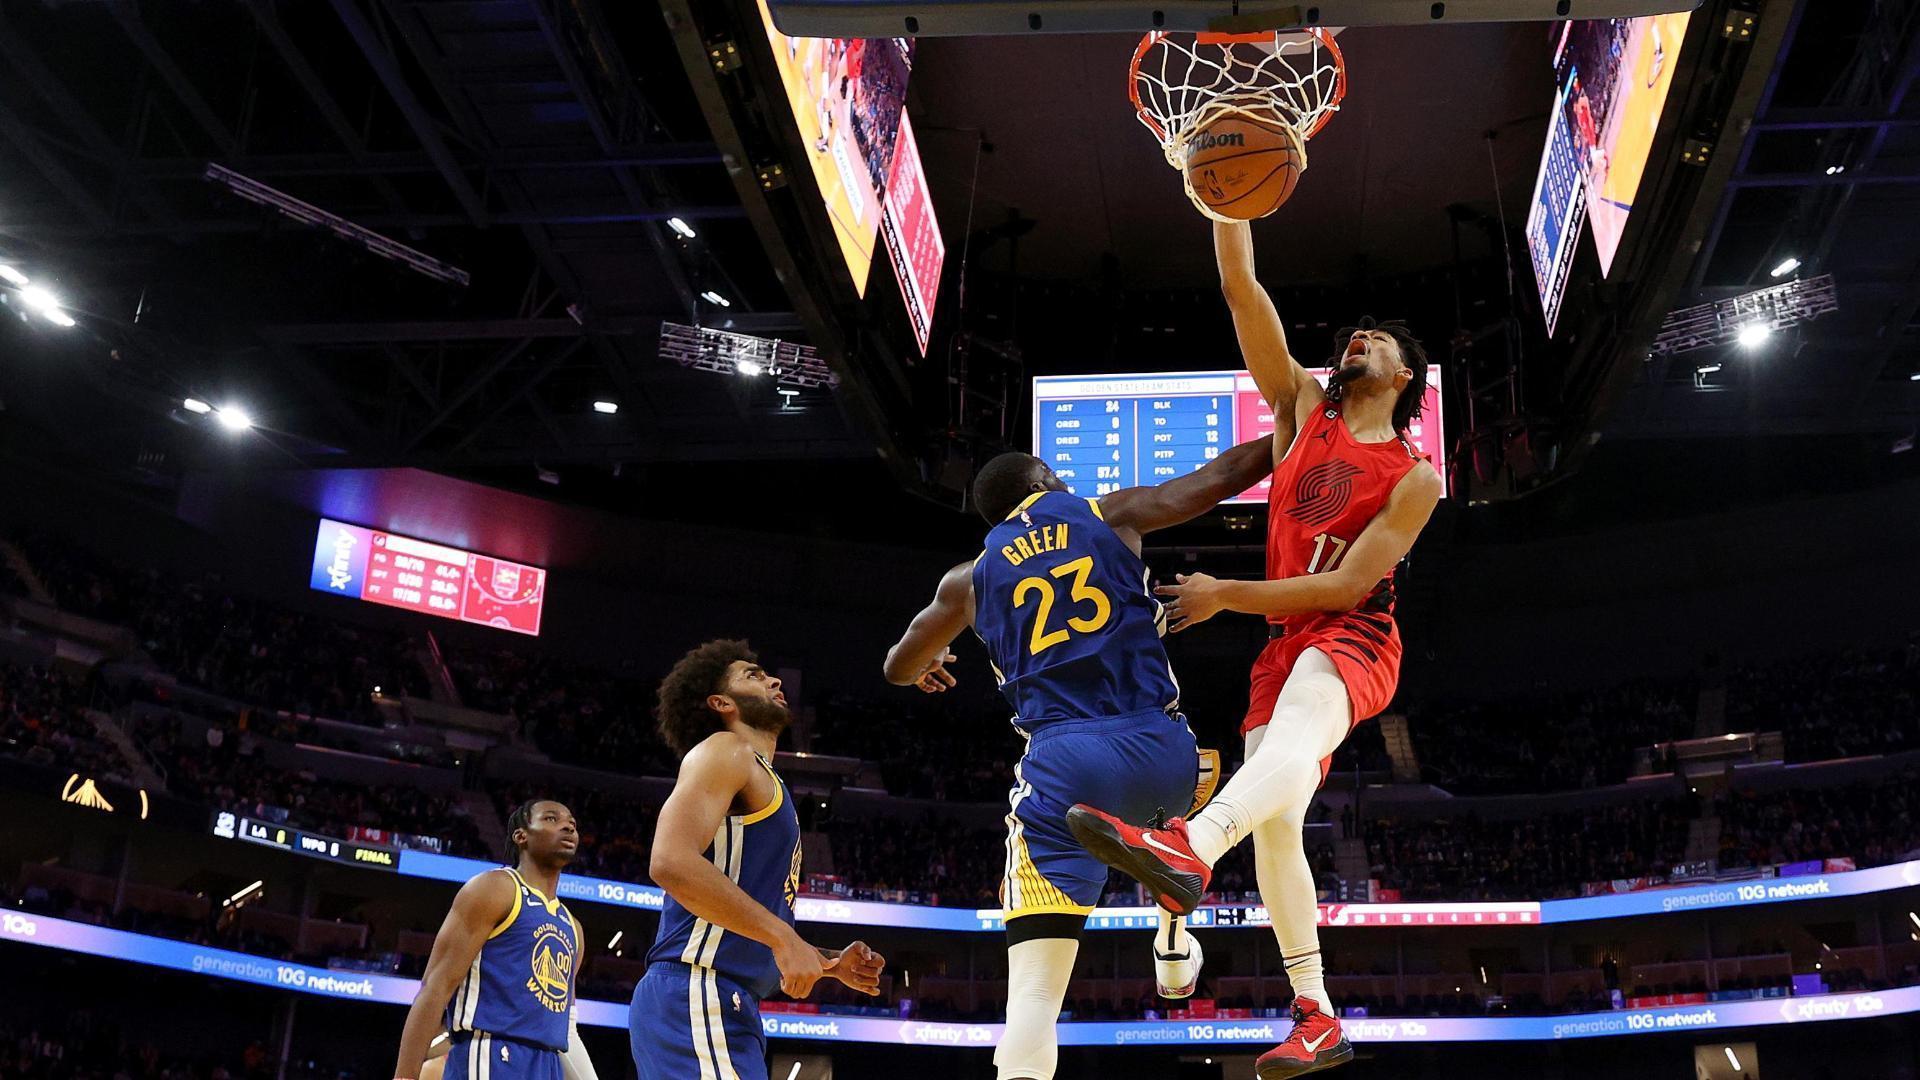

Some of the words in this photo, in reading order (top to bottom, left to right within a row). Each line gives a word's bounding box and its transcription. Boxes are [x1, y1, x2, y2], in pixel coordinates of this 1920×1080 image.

[1056, 403, 1073, 412] AST
[1153, 401, 1171, 410] BLK
[1211, 398, 1218, 410] 1
[1154, 417, 1167, 426] TO
[1325, 409, 1337, 419] 6
[1056, 420, 1080, 429] OREB
[1056, 437, 1080, 445] DREB
[1154, 434, 1172, 443] POT
[1056, 453, 1072, 462] STL
[1112, 450, 1120, 462] 4
[1154, 450, 1175, 459] PITP
[1154, 467, 1175, 475] FG%
[1001, 523, 1070, 567] GREEN
[1306, 532, 1347, 574] 17
[327, 528, 358, 590] xfinity
[1012, 555, 1112, 657] 23
[252, 825, 268, 838] LA
[355, 849, 392, 865] FINAL
[597, 884, 625, 900] 10G
[627, 889, 663, 906] netw
[1663, 890, 1735, 912] generation
[1737, 885, 1766, 901] 10G
[1768, 879, 1830, 899] network
[533, 923, 558, 938] GOLDEN
[557, 951, 570, 974] 00
[192, 954, 273, 980] generation
[276, 965, 306, 987] 10G
[307, 973, 373, 996] network
[526, 977, 568, 1013] WARRIO
[1797, 998, 1850, 1019] xfinity
[781, 1021, 839, 1036] network
[1349, 1021, 1397, 1040] xfinity
[1553, 1015, 1624, 1039] generation
[1626, 1014, 1654, 1030] 10G
[1656, 1010, 1717, 1028] network
[915, 1024, 963, 1044] xfinity
[1116, 1027, 1184, 1044] generation
[1187, 1025, 1214, 1040] 10G
[1216, 1024, 1273, 1040] network
